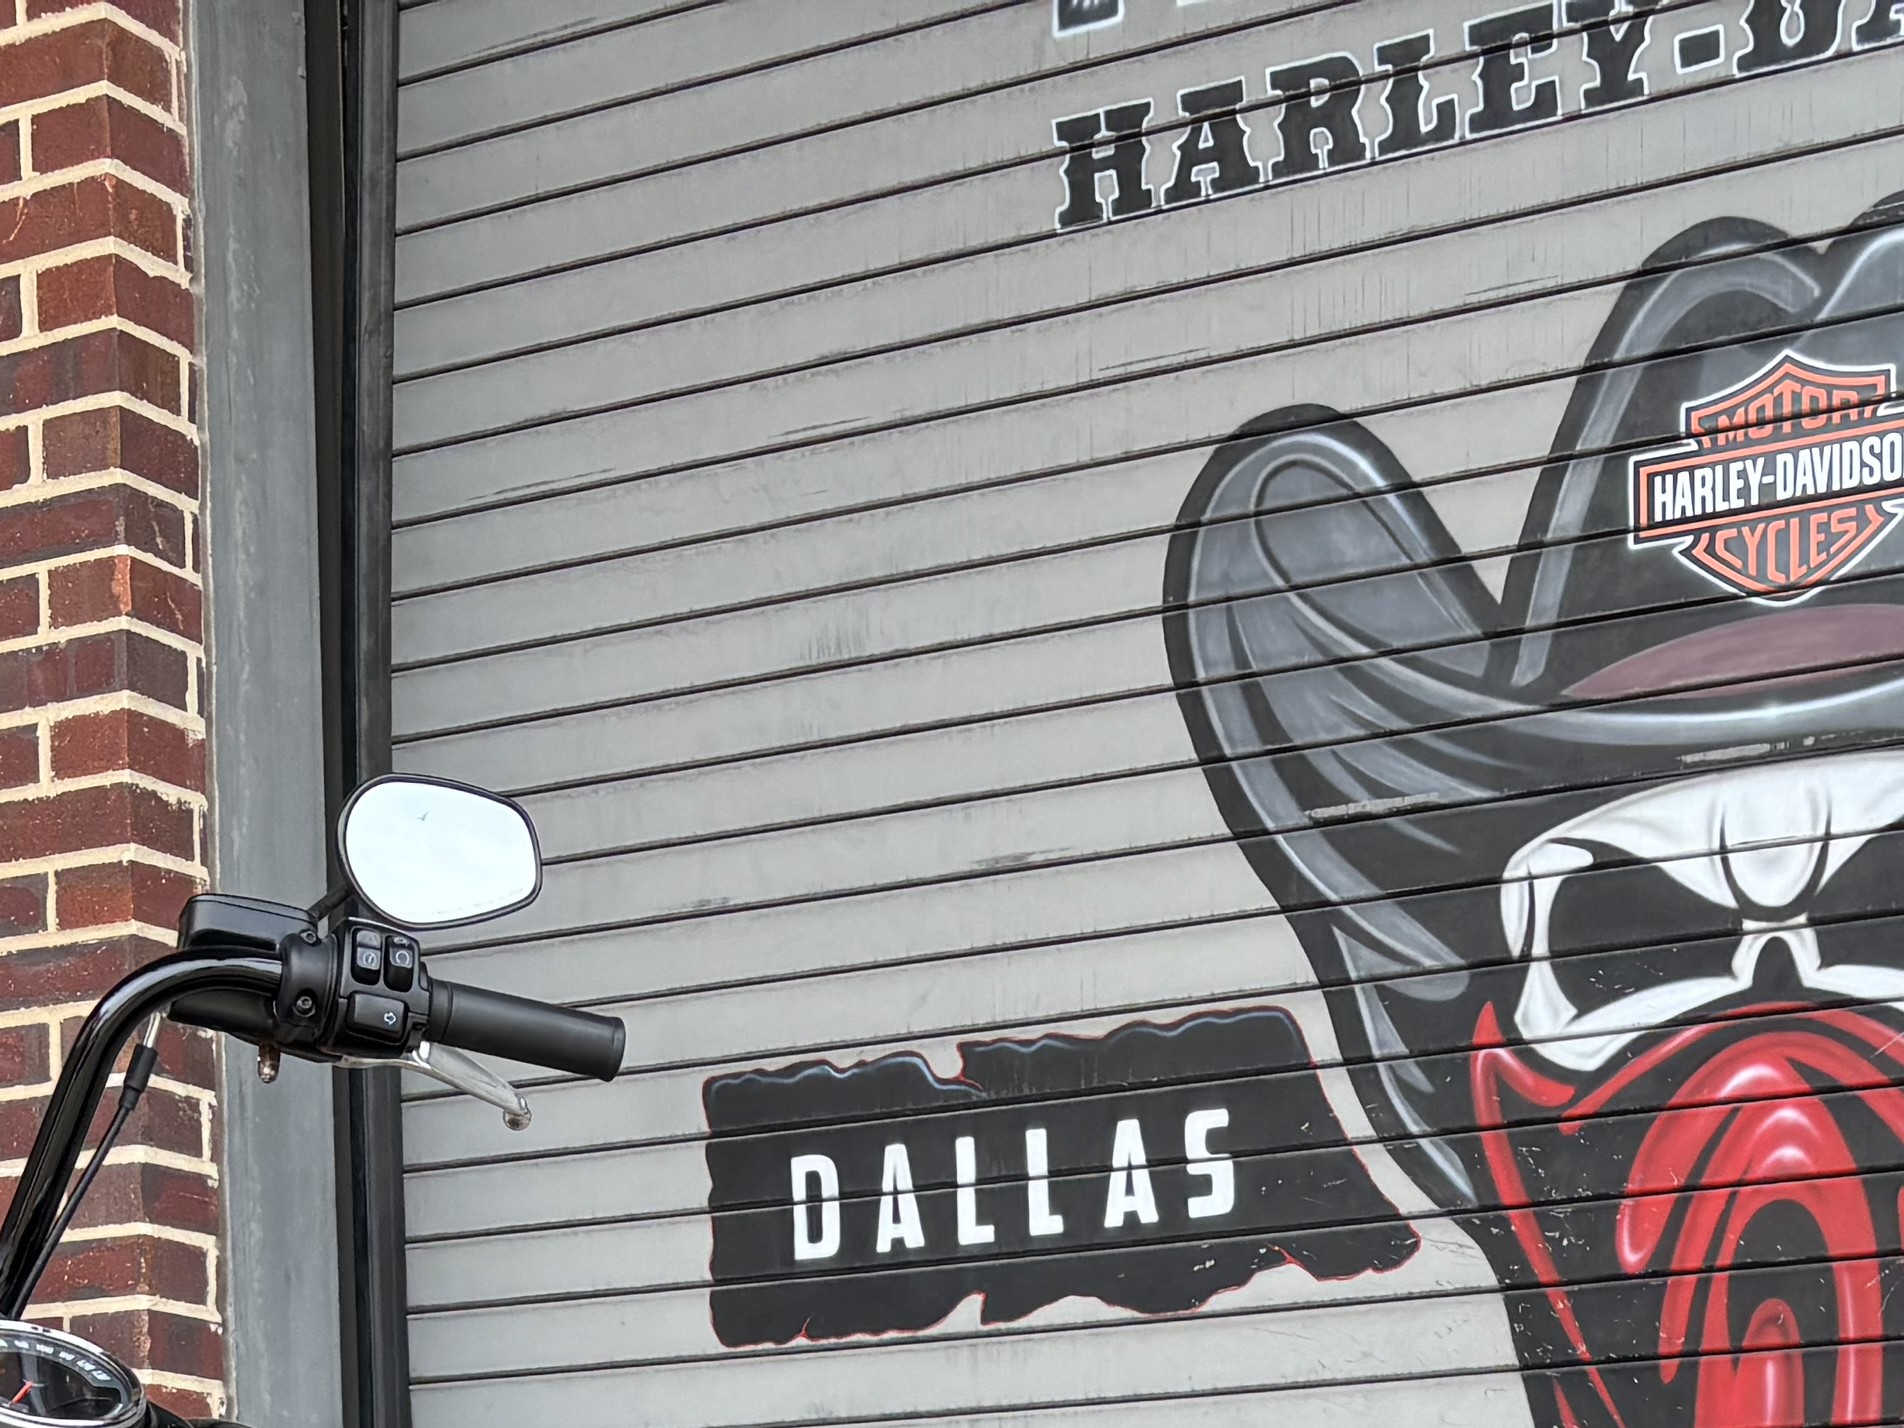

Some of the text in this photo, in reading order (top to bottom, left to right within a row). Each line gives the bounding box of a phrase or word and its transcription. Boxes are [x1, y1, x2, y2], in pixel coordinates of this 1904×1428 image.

[1717, 380, 1860, 449] MOTOR
[1714, 506, 1858, 585] CYCLES
[790, 1107, 1236, 1261] DALLAS
